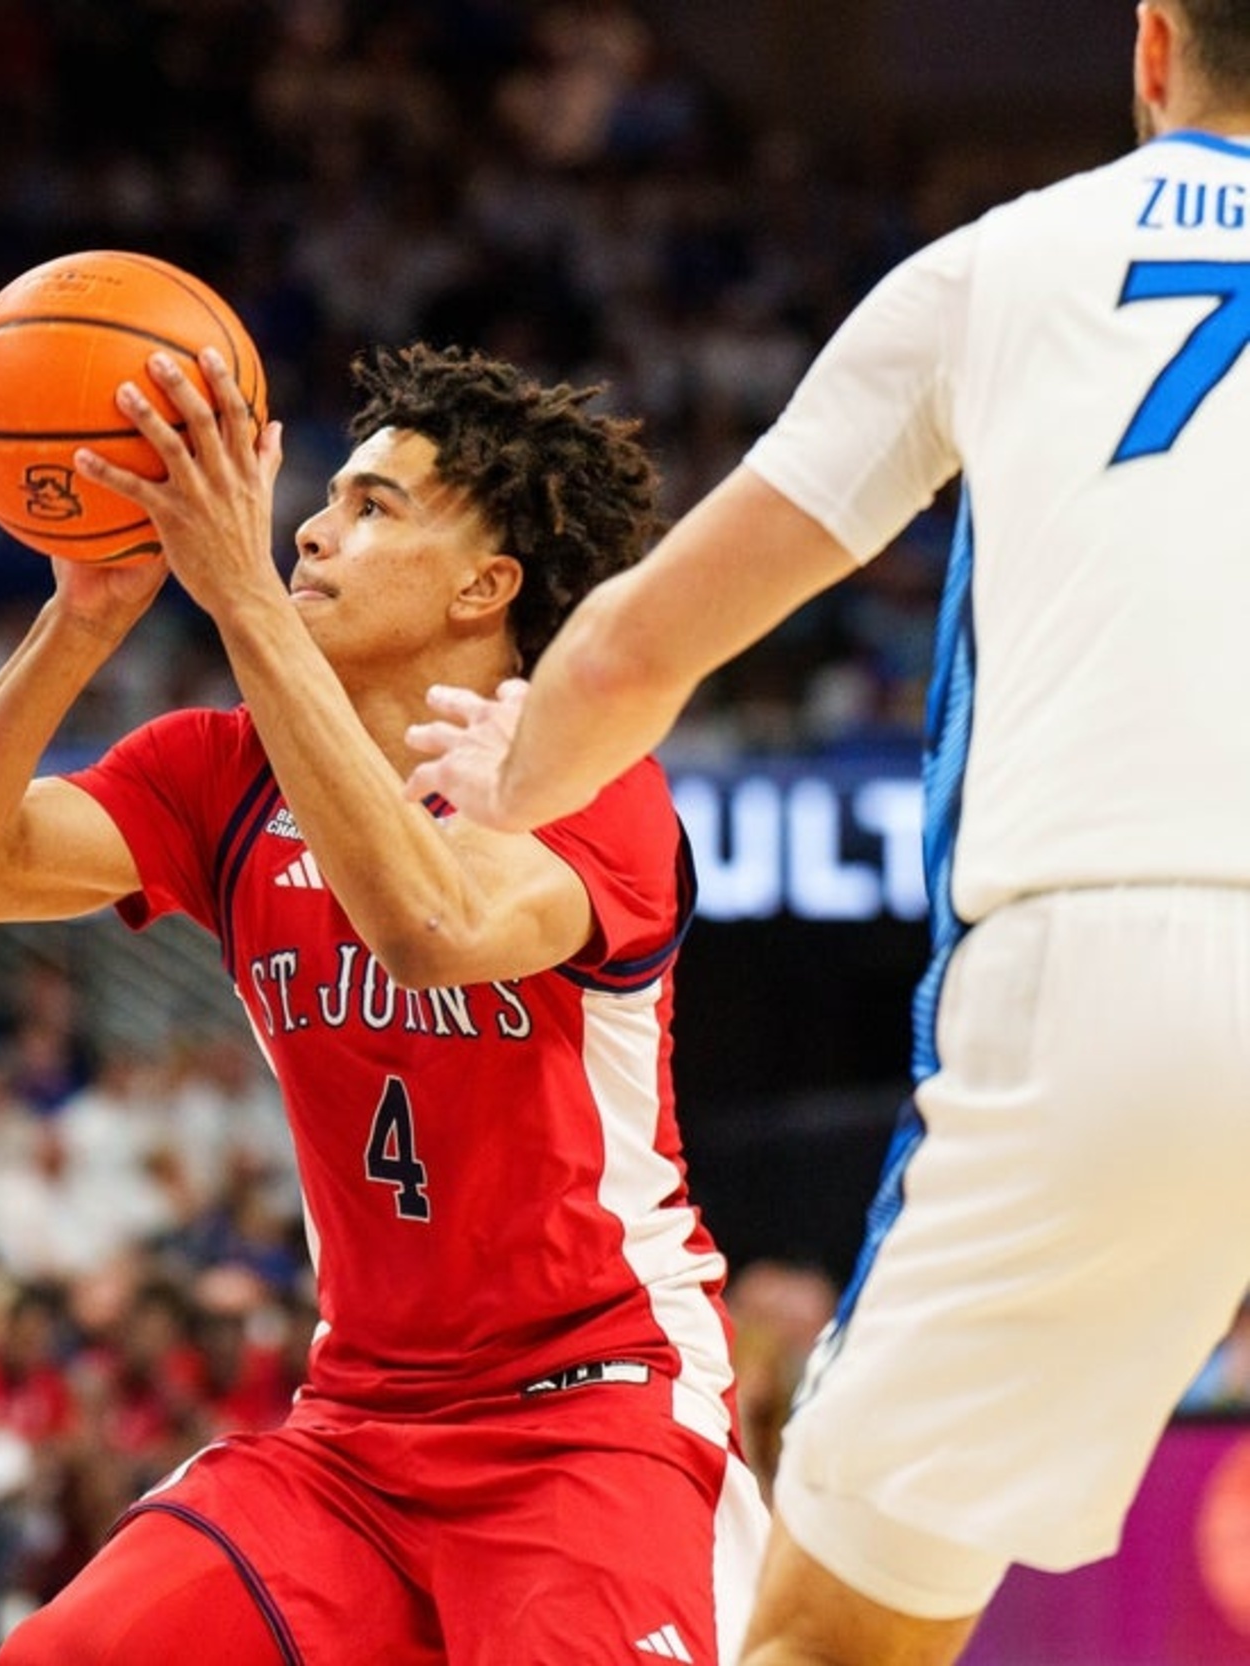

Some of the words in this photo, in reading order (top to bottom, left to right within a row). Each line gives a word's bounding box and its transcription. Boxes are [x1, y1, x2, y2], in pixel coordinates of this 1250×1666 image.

[1136, 175, 1247, 230] ZUG
[1106, 258, 1250, 468] 7
[249, 949, 309, 1038] ST.
[316, 943, 534, 1040] JOHNS
[363, 1074, 430, 1224] 4
